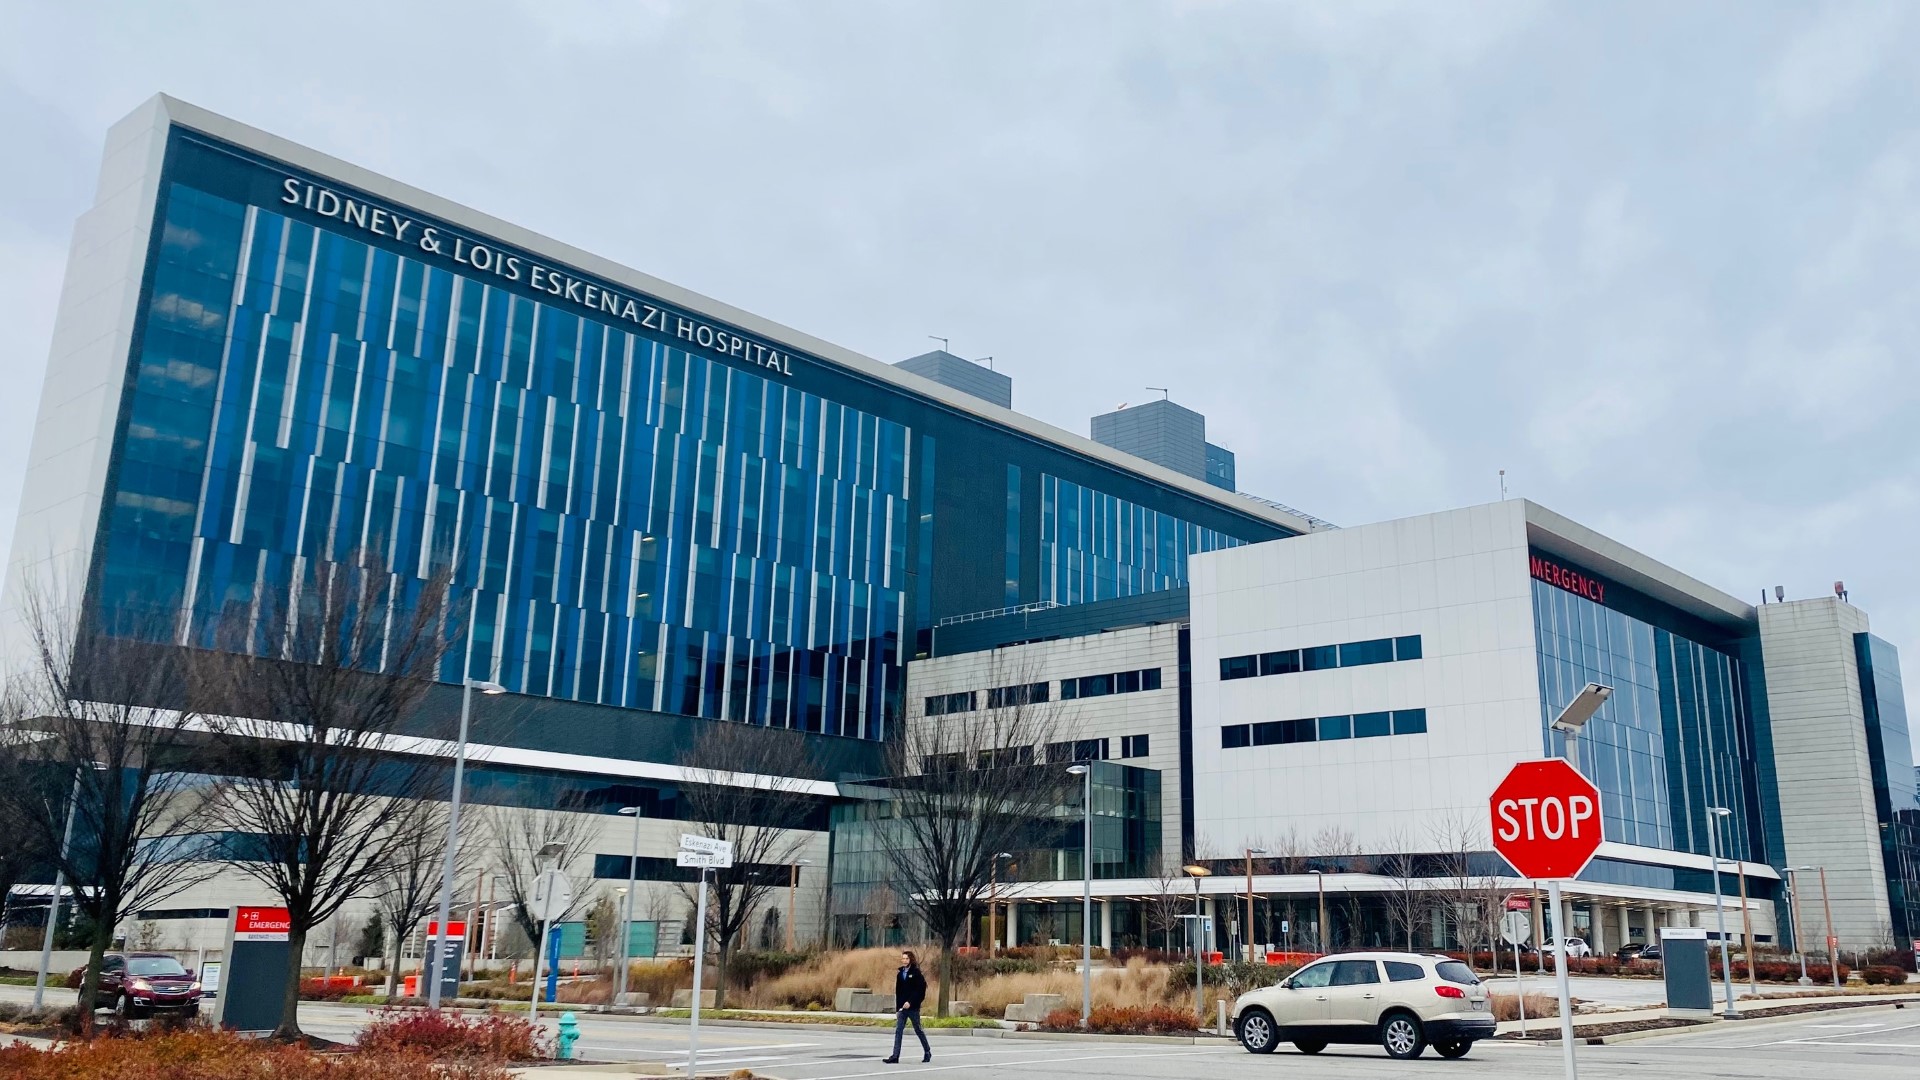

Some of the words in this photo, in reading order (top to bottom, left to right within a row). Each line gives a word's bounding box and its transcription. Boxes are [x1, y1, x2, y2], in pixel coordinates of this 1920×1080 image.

[281, 178, 411, 240] SIDNEY
[419, 227, 442, 255] &
[453, 238, 521, 281] LOIS
[530, 265, 666, 332] ESKENAZI
[677, 317, 793, 377] HOSPITAL
[1531, 555, 1605, 603] MERGENCY
[1498, 795, 1593, 842] STOP
[684, 854, 707, 864] Smith
[708, 855, 725, 865] Blvd
[685, 837, 713, 850] Eskenazi
[714, 843, 727, 853] Ave
[249, 921, 291, 929] EMERGENC
